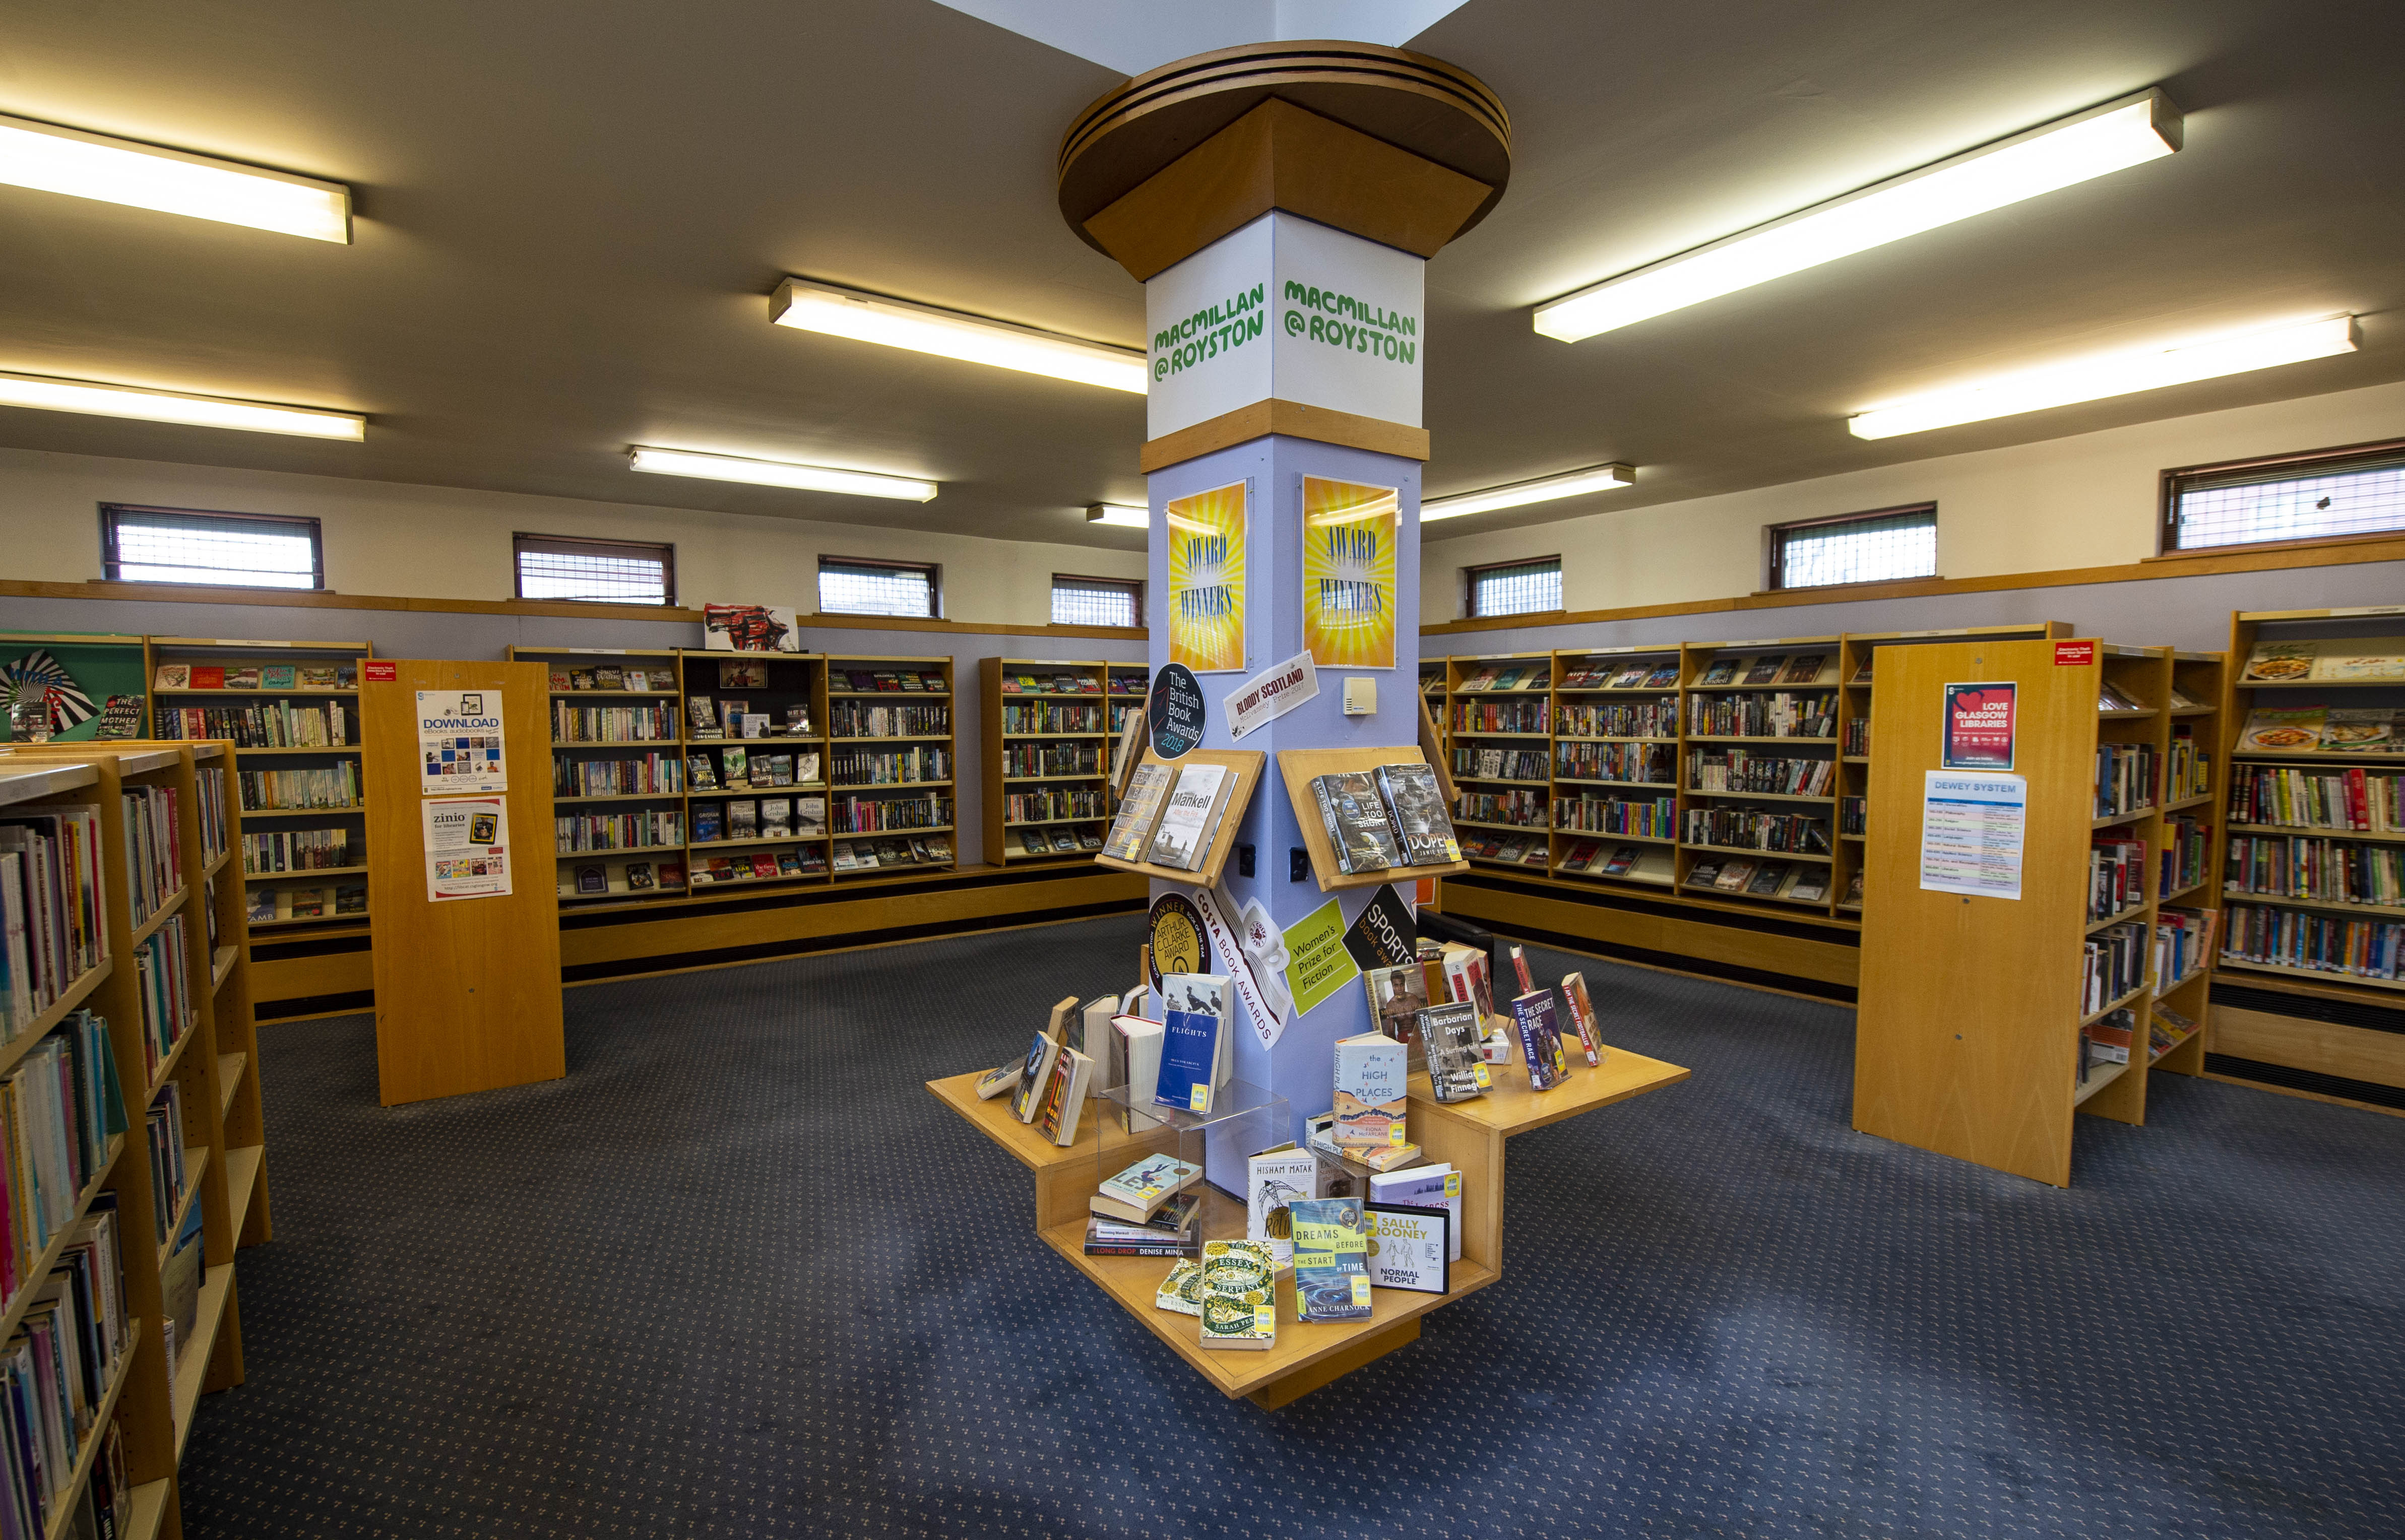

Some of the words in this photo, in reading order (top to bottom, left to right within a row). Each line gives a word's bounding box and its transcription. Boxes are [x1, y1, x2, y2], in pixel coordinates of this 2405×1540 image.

[1285, 280, 1416, 336] MACMILLAN
[1154, 283, 1263, 353] MACMILLAN
[1186, 532, 1227, 569] AWARD
[1326, 526, 1376, 561] AWARD
[1180, 584, 1232, 618] WINNERS
[1320, 578, 1382, 613] WINNERS
[10, 668, 49, 684] WITH
[52, 676, 62, 686] A
[877, 681, 901, 690] FIX
[1169, 671, 1186, 689] The
[1236, 689, 1260, 716] BLOODY
[1260, 668, 1304, 699] SCOTLAND
[1291, 681, 1305, 695] 2017
[1169, 689, 1199, 710] British
[1168, 702, 1190, 722] Book
[423, 718, 499, 729] DOWNLOAD
[1166, 718, 1199, 741] Awards
[1161, 734, 1185, 752] 2018
[1133, 789, 1156, 799] BARRY
[1935, 782, 1970, 790] DEWEY
[1974, 784, 2015, 793] SYSTEM
[1128, 803, 1147, 814] DAYS
[1171, 793, 1211, 809] Mankell
[1316, 786, 1324, 800] LIFE
[1325, 811, 1336, 832] SHORT
[1361, 802, 1380, 810] LIFE
[433, 812, 465, 823] zinio
[1364, 810, 1382, 818] TOO
[1387, 810, 1399, 833] DOPED
[1116, 816, 1150, 830] WITHOUT
[1117, 833, 1132, 844] END
[1151, 902, 1185, 928] WINNER
[1157, 918, 1186, 940] ARTHUR
[1256, 923, 1265, 938] COSTA
[1359, 918, 1378, 948] book
[1293, 925, 1335, 957] Women's
[1164, 940, 1189, 960] AWARD
[1298, 955, 1322, 974] Prize
[1323, 943, 1336, 958] for
[1152, 958, 1160, 978] SCIENCE
[1198, 893, 1220, 939] COSTA
[1219, 940, 1239, 978] BOOK
[1238, 981, 1271, 1040] AWARDS
[1303, 965, 1334, 989] Fiction
[1524, 1006, 1535, 1018] THE
[1536, 997, 1554, 1013] SECRET
[1419, 1014, 1428, 1041] Finnegan
[1432, 1013, 1473, 1026] Barbarian
[1527, 1015, 1543, 1031] RACE
[1570, 1004, 1579, 1022] SECRET
[1576, 1019, 1589, 1046] FOOTBALLER
[1172, 1026, 1207, 1037] FLIGHTS
[1445, 1026, 1465, 1036] Days
[1519, 1017, 1531, 1043] SECRET
[1526, 1043, 1535, 1060] RACE
[1446, 1046, 1467, 1055] Surfing
[1468, 1043, 1479, 1051] Life
[1431, 1045, 1440, 1075] Barbarian
[1362, 1071, 1387, 1080] HIGH
[1356, 1088, 1393, 1097] PLACES
[1317, 1140, 1332, 1151] HIGH
[1333, 1145, 1354, 1160] PLACES
[1257, 1166, 1285, 1175] HISHAM
[1290, 1165, 1312, 1174] MATAR
[1382, 1217, 1419, 1230] SALLY
[1296, 1230, 1339, 1240] DREAMS
[1336, 1241, 1363, 1249] BEFORE
[1220, 1259, 1251, 1268] ESSEX
[1343, 1263, 1364, 1271] TIME
[1380, 1268, 1420, 1278] NORMAL
[1383, 1275, 1416, 1285] PEOPLE
[1216, 1282, 1260, 1293] SERPENT
[1215, 1321, 1240, 1330] SARAH
